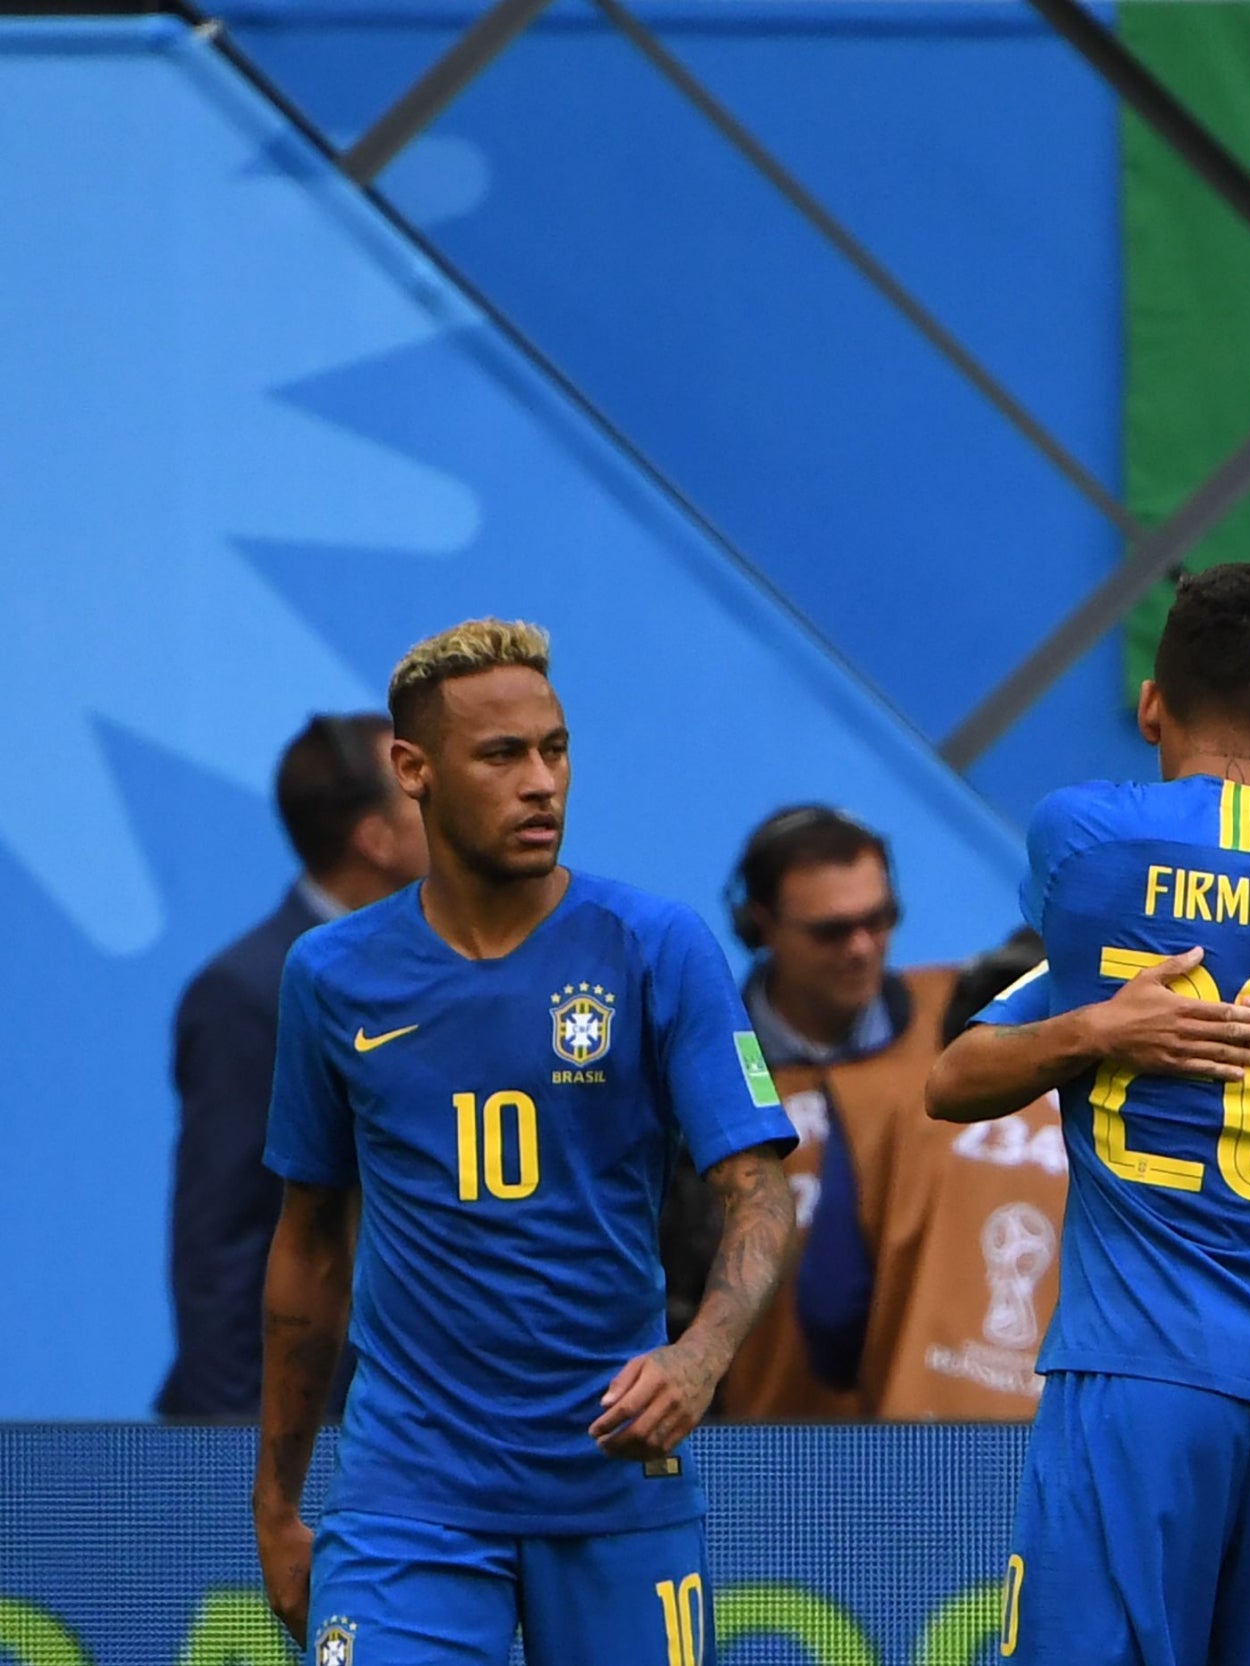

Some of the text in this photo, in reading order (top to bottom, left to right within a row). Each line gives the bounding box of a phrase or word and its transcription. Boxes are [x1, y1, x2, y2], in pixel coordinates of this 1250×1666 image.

[552, 1070, 606, 1084] BRASIL
[453, 1090, 539, 1201] 10
[656, 1572, 704, 1666] 10
[1001, 1554, 1024, 1657] 0
